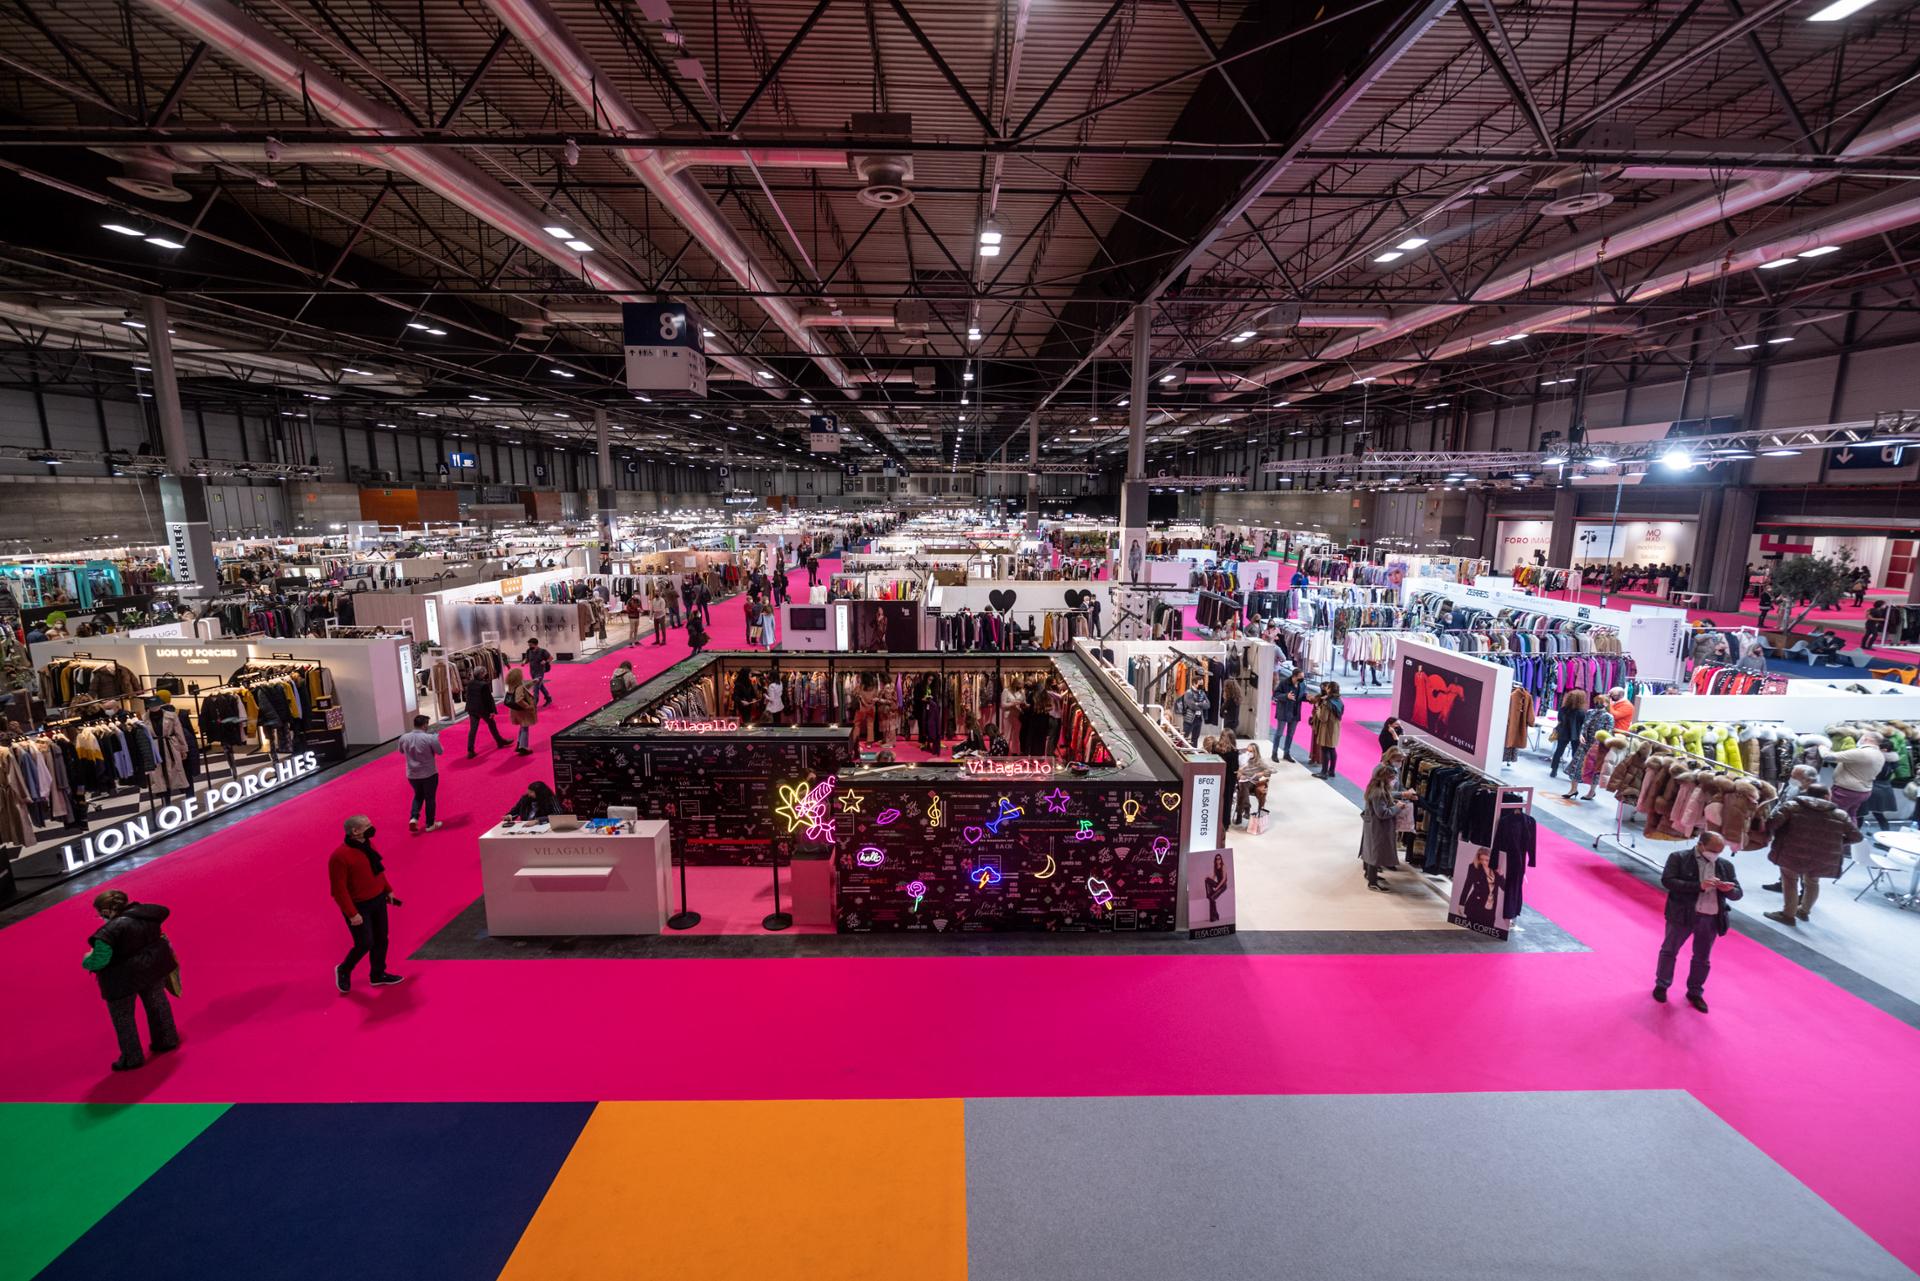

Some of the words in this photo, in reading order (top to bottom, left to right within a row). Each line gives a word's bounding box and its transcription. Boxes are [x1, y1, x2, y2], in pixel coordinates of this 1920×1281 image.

[660, 312, 678, 340] 8
[825, 418, 834, 431] 8
[439, 464, 448, 474] A
[536, 466, 544, 476] B
[628, 463, 636, 472] C
[720, 467, 728, 477] D
[848, 465, 855, 475] E
[1504, 537, 1529, 545] FORO
[516, 623, 578, 633] CONDE
[156, 649, 179, 657] LION
[180, 649, 193, 657] OF
[195, 649, 237, 657] PORCHES
[664, 720, 738, 734] Vilagallo
[966, 759, 1052, 777] Vilagallo
[1202, 788, 1211, 808] ELISA
[63, 815, 150, 872] LION
[156, 797, 198, 830] OF
[206, 751, 318, 813] PORCHES
[534, 846, 605, 856] VILAGALLO
[860, 851, 881, 862] hello
[1455, 916, 1472, 929] ELISA
